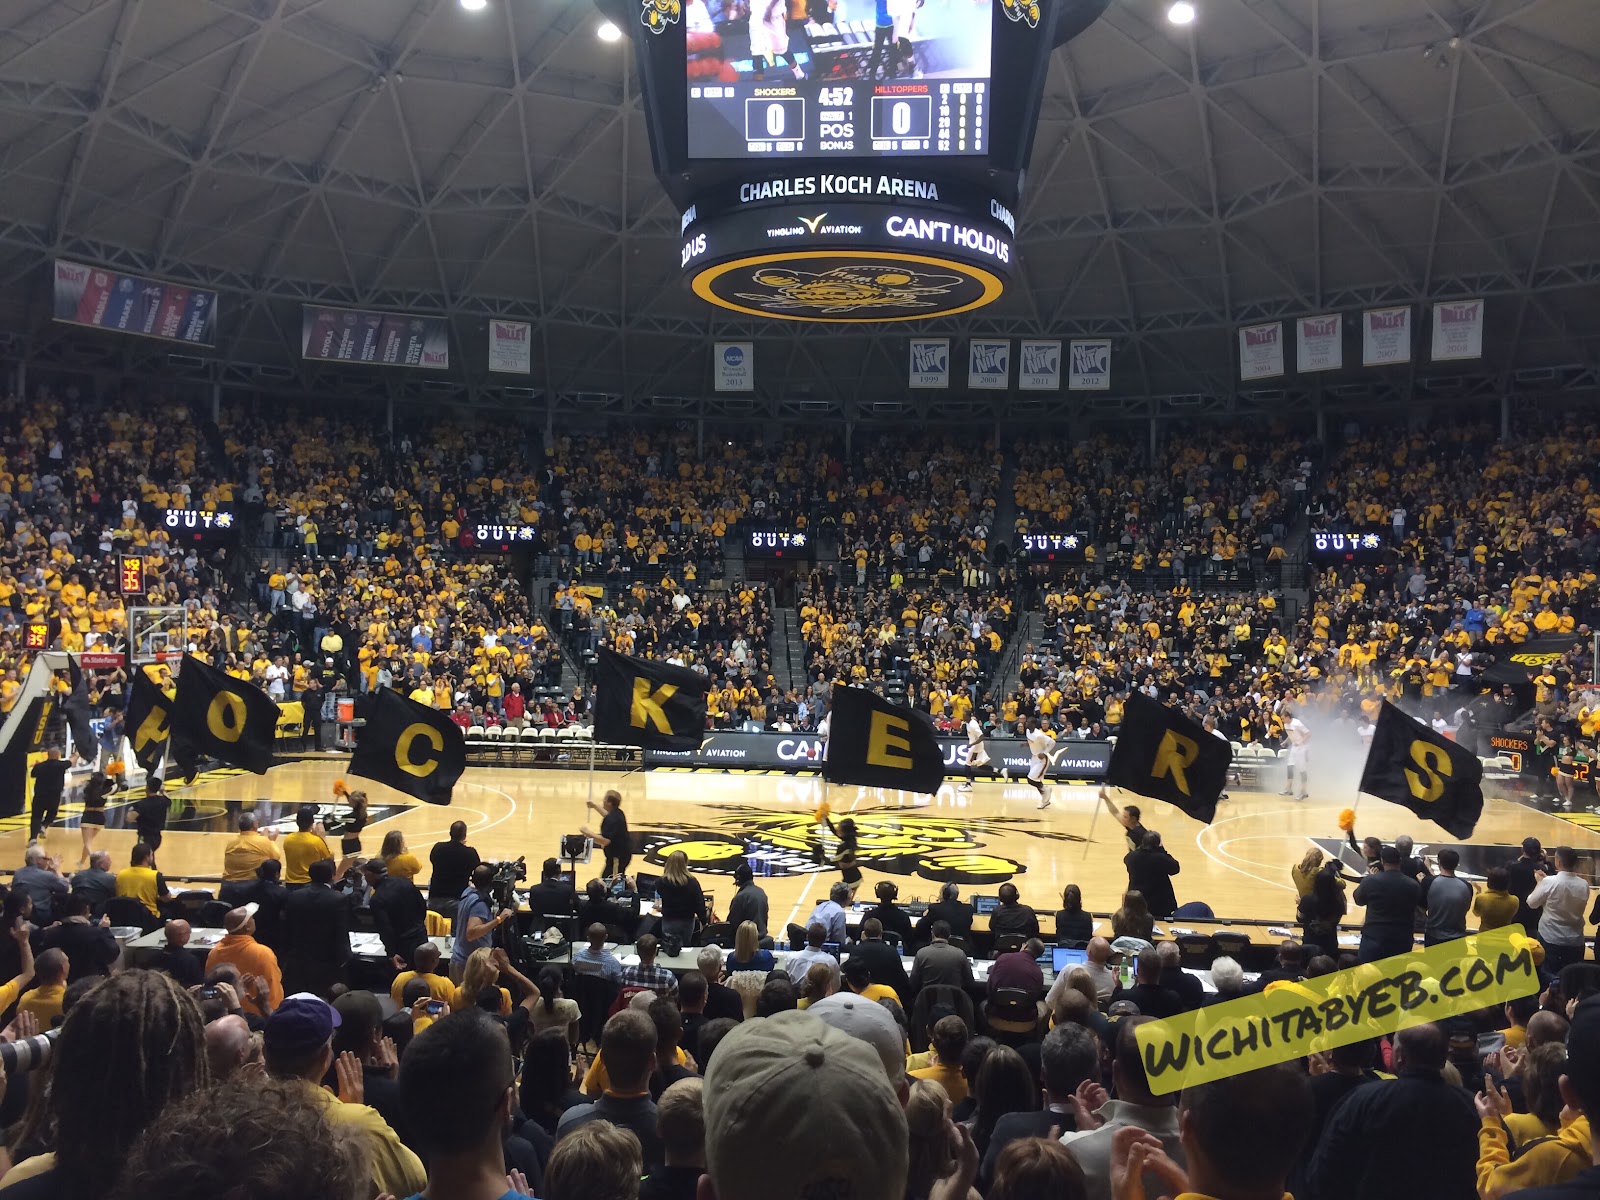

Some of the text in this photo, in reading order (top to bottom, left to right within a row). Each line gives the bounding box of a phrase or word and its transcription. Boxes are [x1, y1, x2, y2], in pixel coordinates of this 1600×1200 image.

[754, 88, 796, 96] SHOCKERS
[818, 87, 854, 106] 4:52
[875, 85, 928, 94] HILLTOPPERS
[766, 103, 785, 136] 0
[892, 102, 911, 135] 0
[820, 124, 854, 138] POS
[820, 141, 854, 150] BONUS
[740, 174, 939, 202] CHARLES KOCH ARENA
[767, 225, 861, 237] YINGLING AVIATION
[886, 216, 1009, 264] CAN'T HOLD US
[692, 233, 706, 256] US
[118, 299, 134, 328] DRAKE
[161, 305, 176, 336] ILLINOIS
[169, 315, 181, 337] STATE
[193, 320, 204, 341] STATE
[321, 330, 334, 357] LOYOLA
[344, 340, 354, 359] STATE
[405, 334, 418, 364] WICHITA
[1447, 345, 1468, 353] 2008
[368, 346, 377, 361] IOWA
[412, 343, 422, 364] STATE
[1376, 350, 1398, 358] 2007
[920, 376, 939, 384] 1999
[1081, 377, 1100, 385] 2012
[166, 515, 212, 528] OUT
[477, 530, 517, 540] OUT
[752, 537, 790, 546] OUT
[1316, 538, 1360, 550] OUT
[124, 571, 138, 590] 35
[30, 634, 42, 646] 35
[630, 676, 679, 736] K
[34, 702, 53, 745] WSU
[206, 690, 248, 743] O
[866, 710, 914, 770] E
[1490, 737, 1528, 750] SHOCKERS
[395, 723, 444, 778] C
[706, 749, 746, 758] AVIATION
[1003, 758, 1103, 768] YINGLI AVIATION
[1151, 728, 1200, 797] R
[1404, 739, 1452, 802] S
[1512, 754, 1520, 770] 0
[741, 850, 836, 873] WSU
